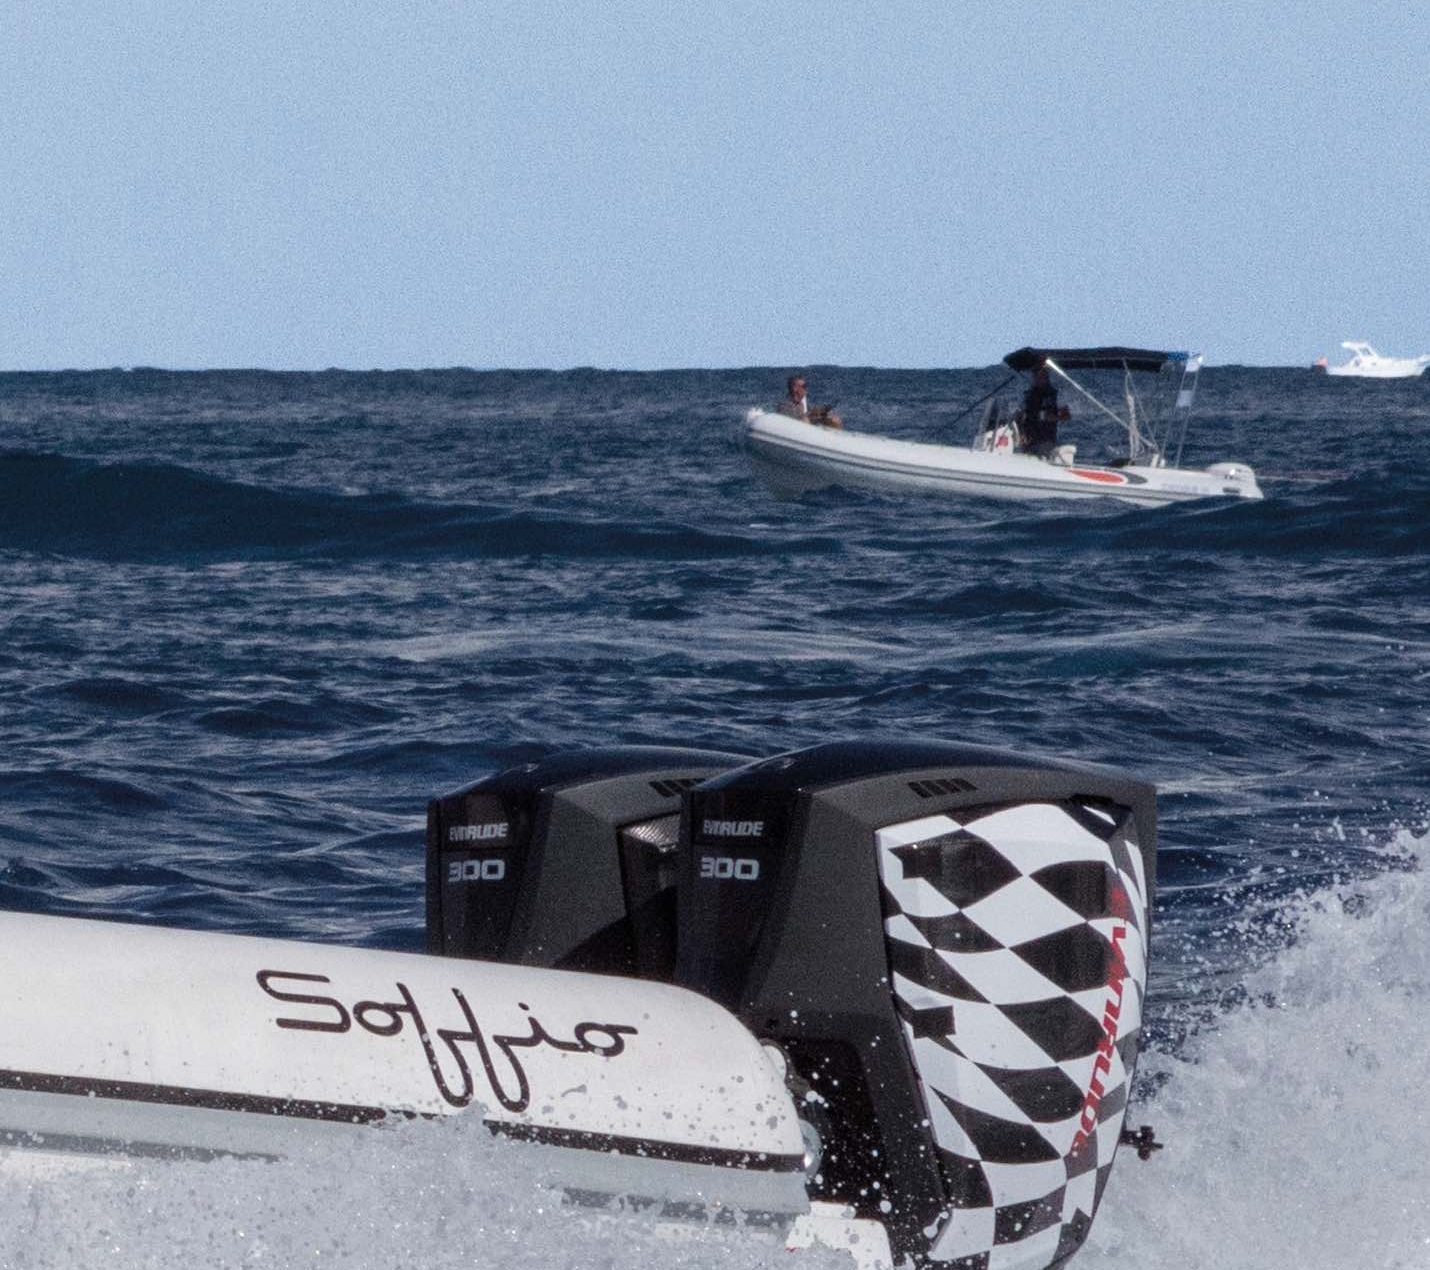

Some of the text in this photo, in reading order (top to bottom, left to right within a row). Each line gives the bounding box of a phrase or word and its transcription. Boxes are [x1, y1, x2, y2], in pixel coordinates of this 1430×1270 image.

[448, 859, 505, 881] 300
[700, 857, 760, 879] 300
[256, 970, 637, 1111] Soffio
